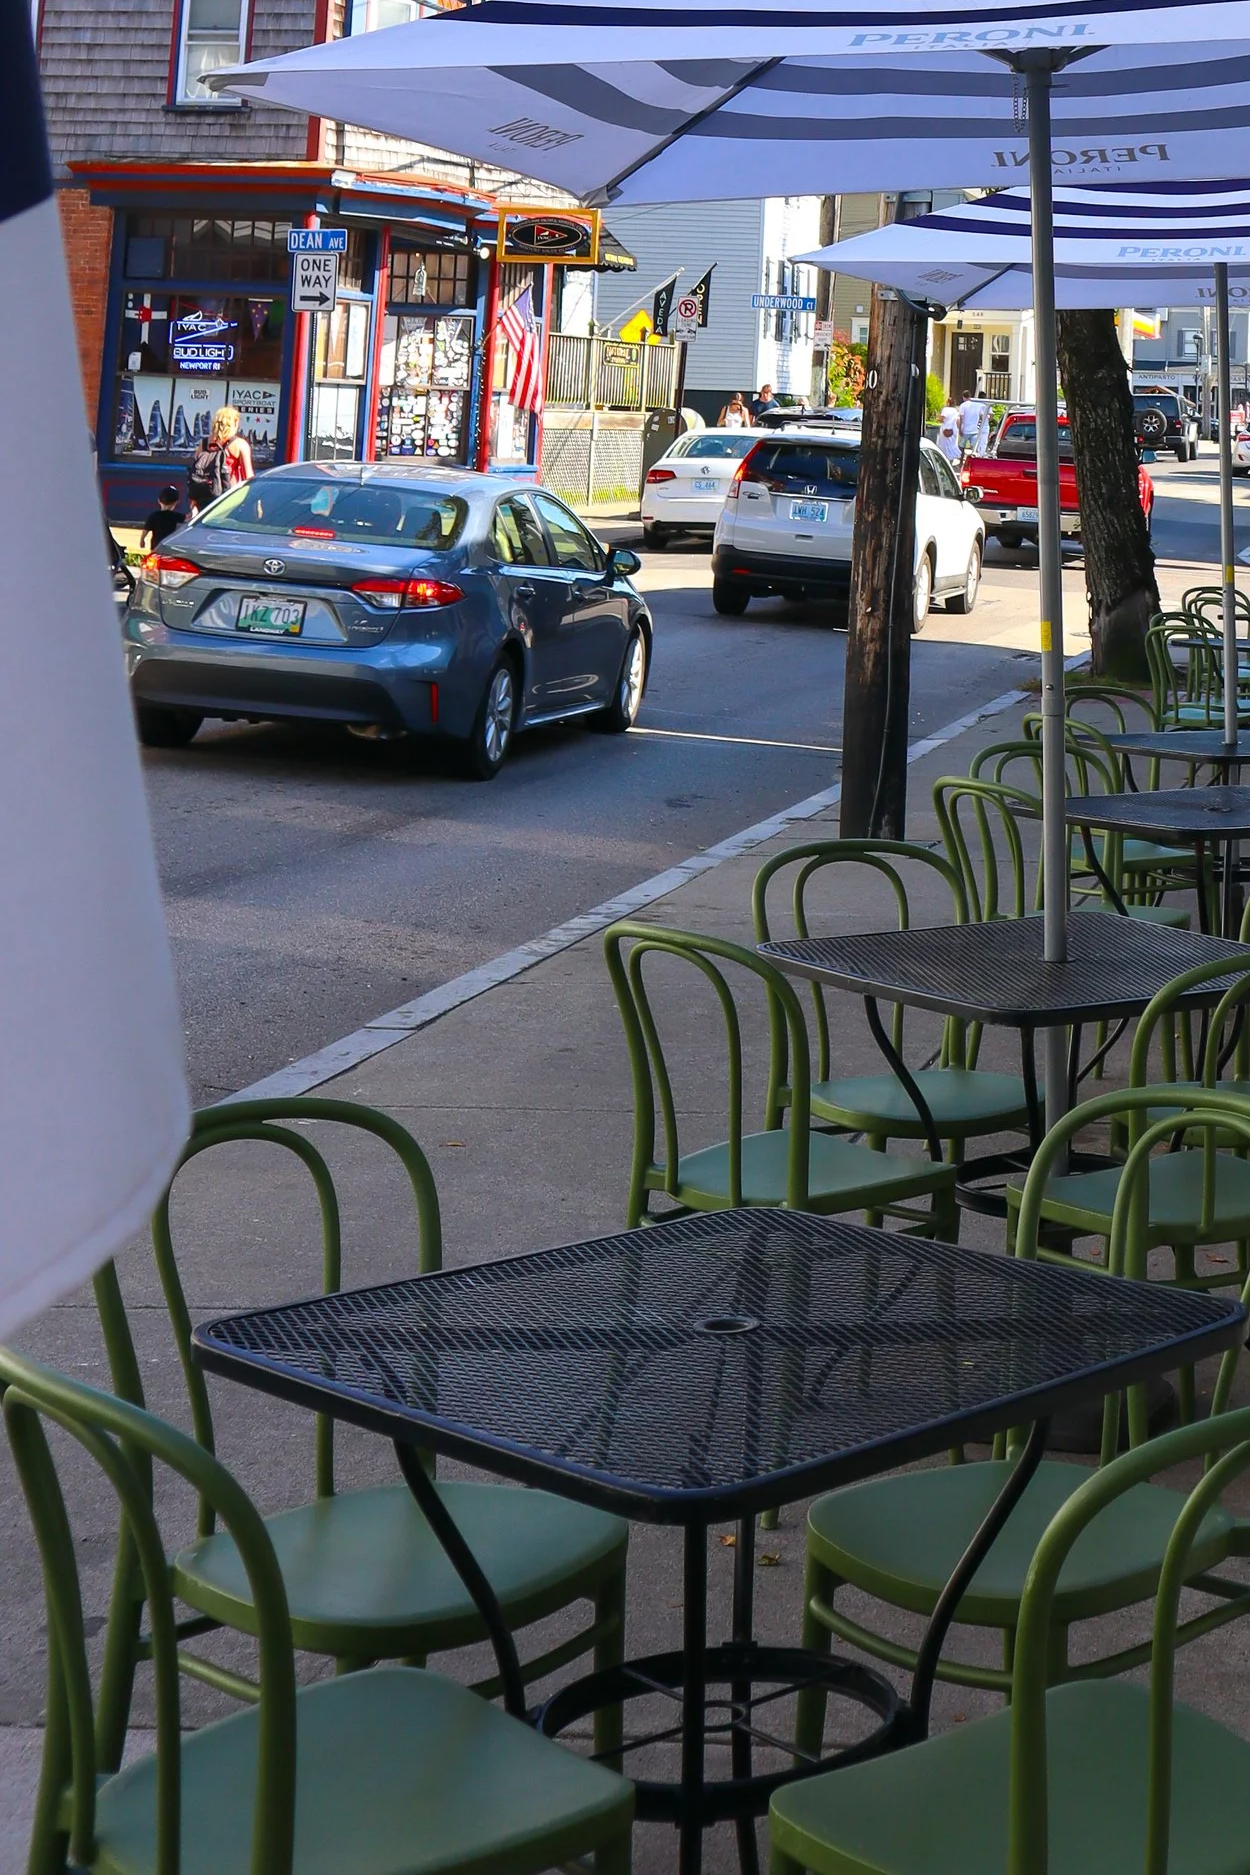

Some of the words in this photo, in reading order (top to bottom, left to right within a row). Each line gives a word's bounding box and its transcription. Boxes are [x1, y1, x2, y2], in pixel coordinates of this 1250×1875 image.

[845, 23, 1091, 47] PERONI
[290, 232, 323, 249] DEAN
[328, 237, 344, 249] AVE
[1116, 246, 1244, 258] PERONI
[300, 258, 332, 272] ONE
[300, 274, 332, 288] WAY
[753, 295, 803, 310] UNDERWOOD
[806, 301, 814, 310] CT
[655, 291, 667, 335] AVEDA
[173, 347, 198, 357] BUD
[180, 361, 212, 371] NEWPORT
[212, 362, 221, 371] RI
[232, 389, 261, 400] IYAC
